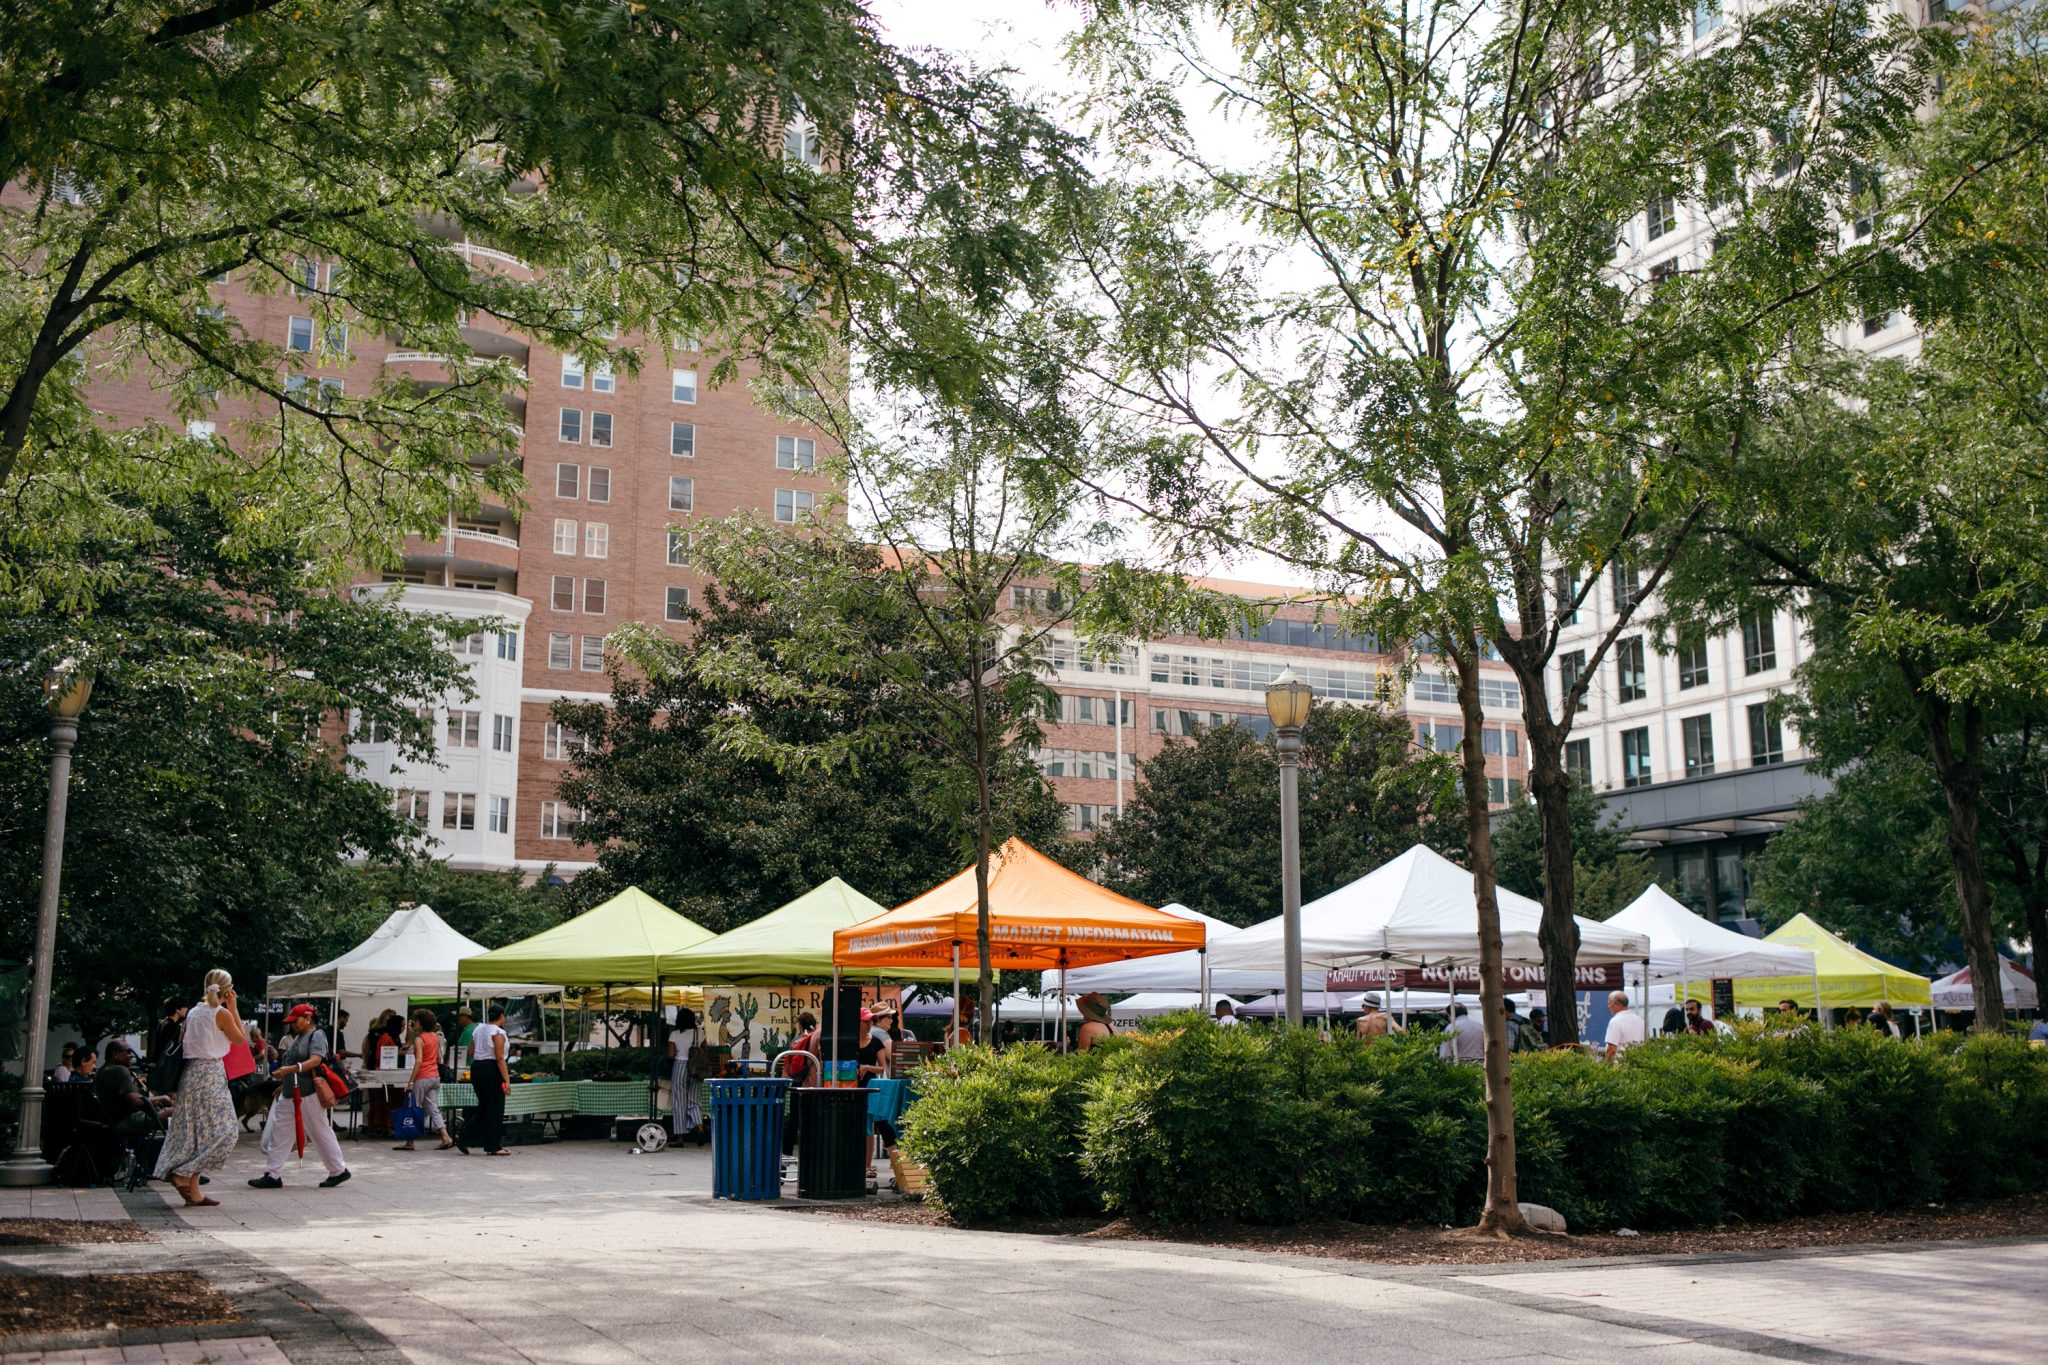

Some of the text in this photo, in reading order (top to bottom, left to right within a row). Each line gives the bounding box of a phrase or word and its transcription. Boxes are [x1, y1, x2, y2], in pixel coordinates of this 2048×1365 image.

[896, 926, 937, 945] MARKETS
[992, 925, 1174, 942] MARKET INFORMATION
[768, 992, 804, 1015] Deep
